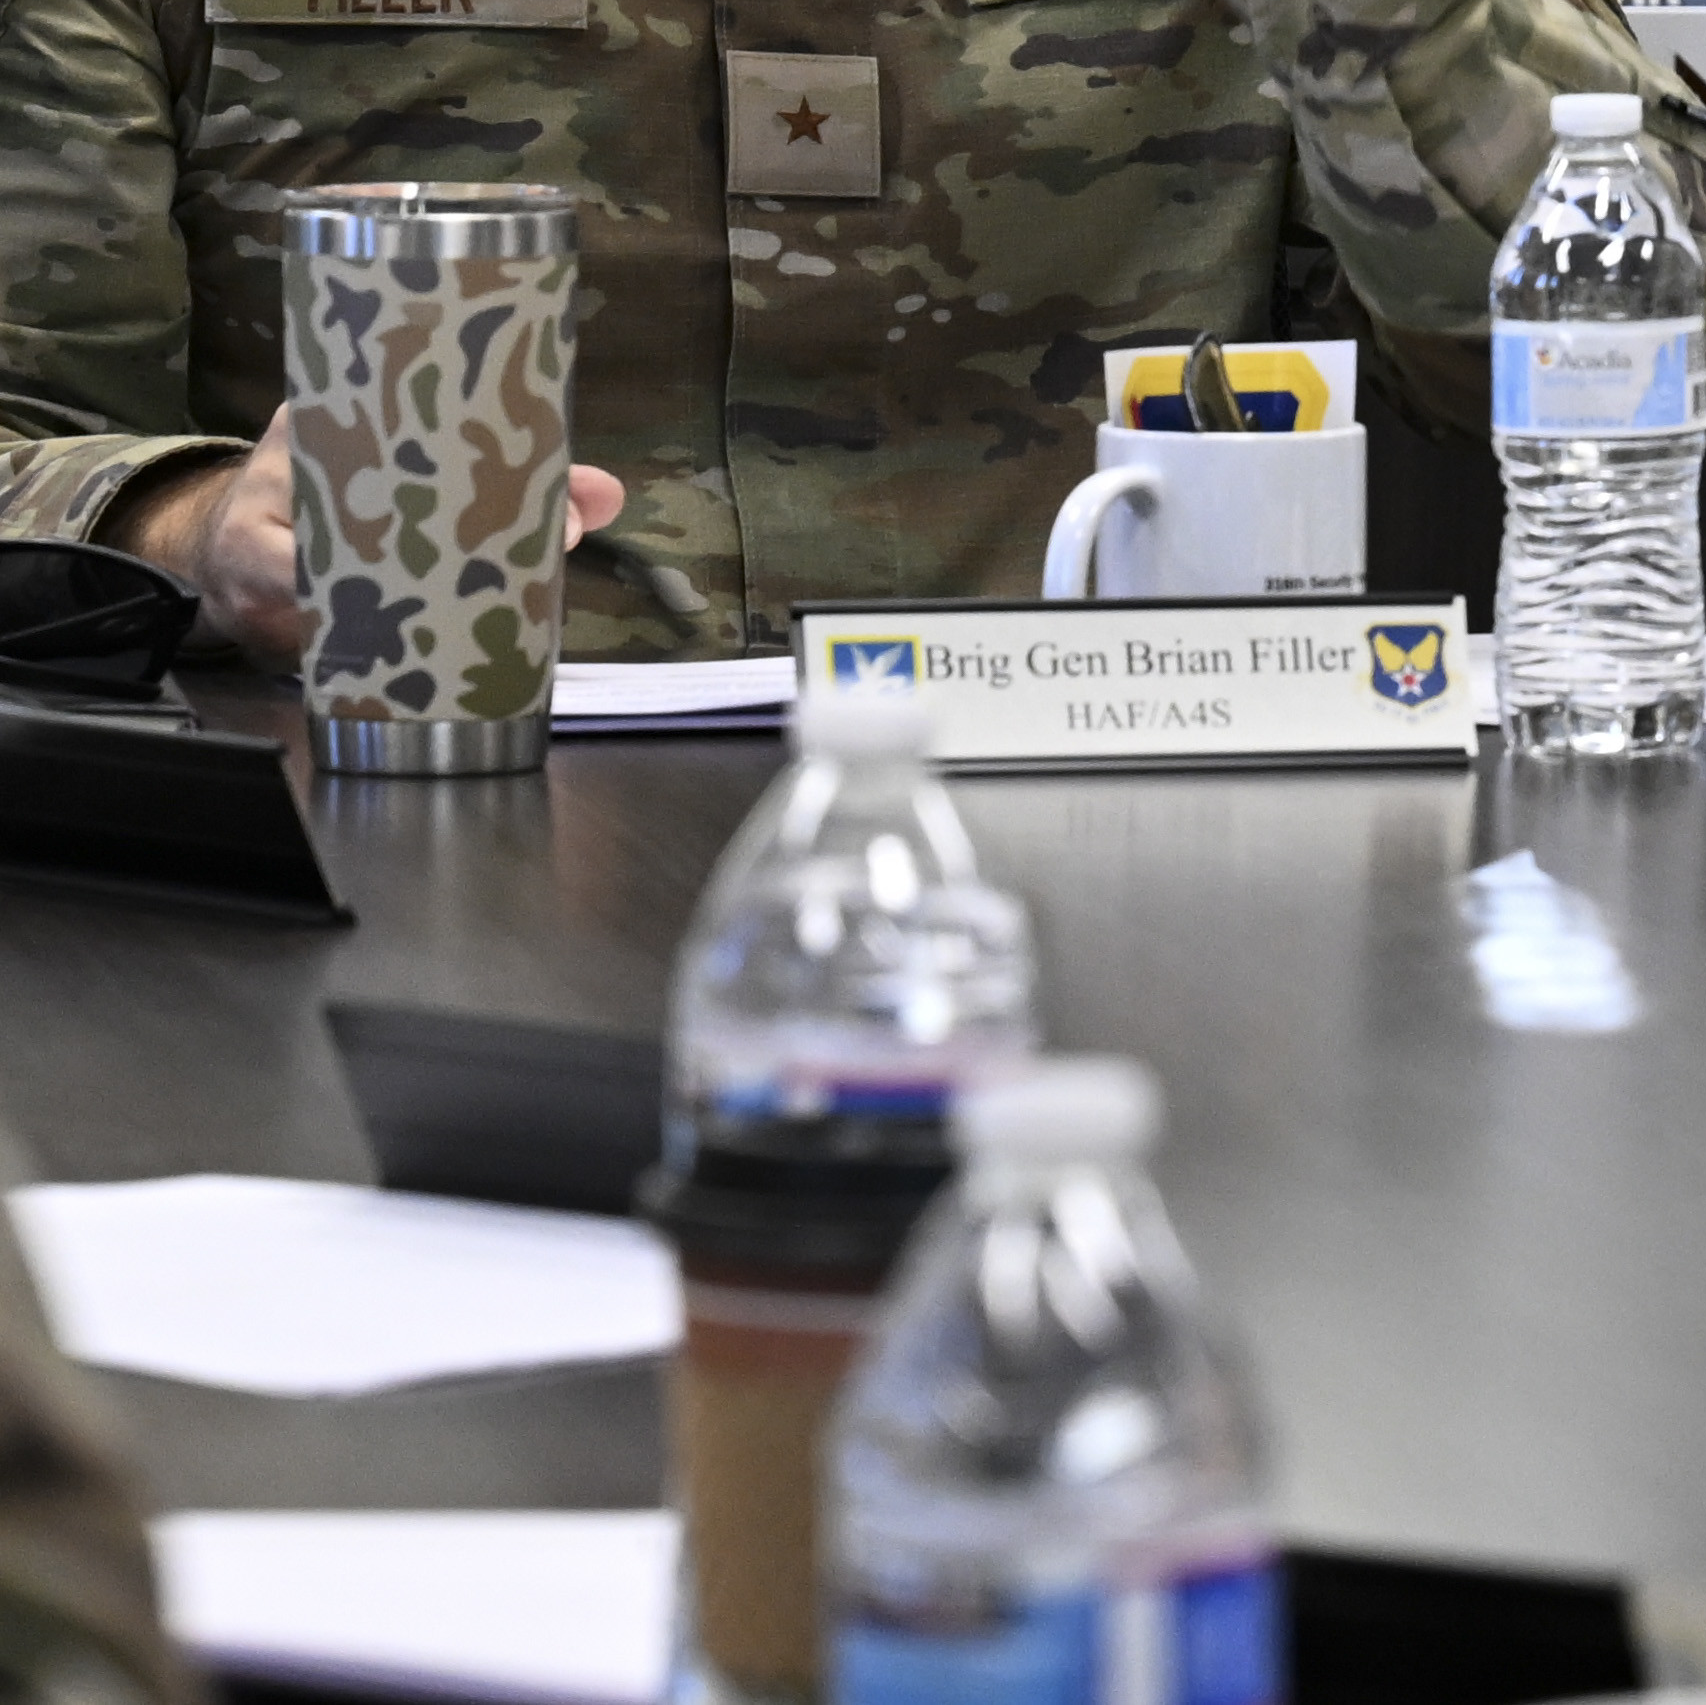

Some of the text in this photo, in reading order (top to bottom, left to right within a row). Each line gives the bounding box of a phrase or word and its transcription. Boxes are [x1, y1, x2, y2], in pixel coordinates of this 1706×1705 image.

[924, 633, 1358, 689] Brig Gen Brian Filler
[1065, 698, 1233, 733] HAF/A4S
